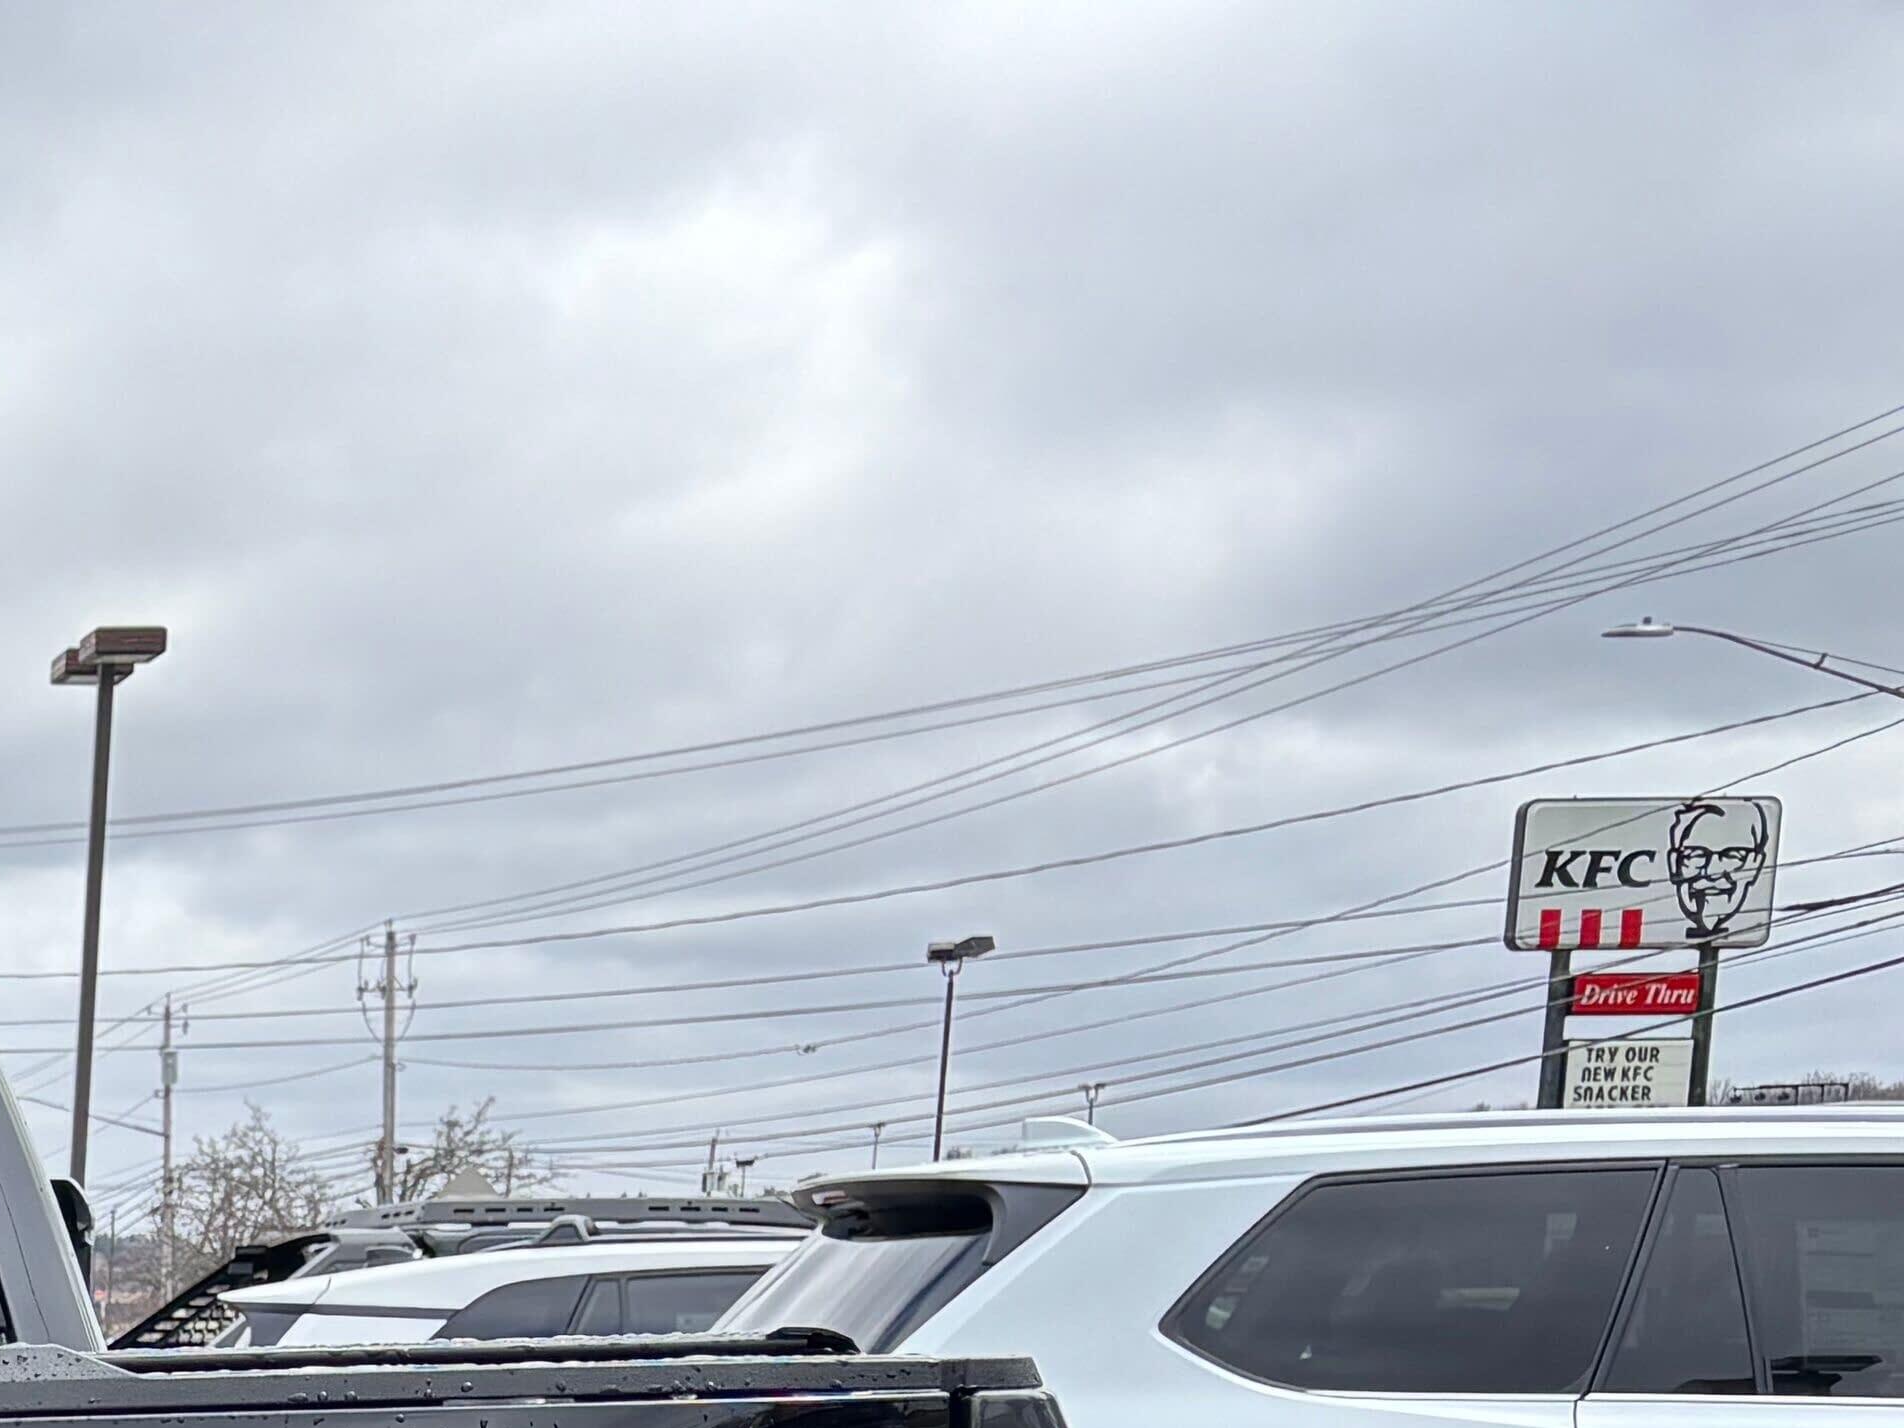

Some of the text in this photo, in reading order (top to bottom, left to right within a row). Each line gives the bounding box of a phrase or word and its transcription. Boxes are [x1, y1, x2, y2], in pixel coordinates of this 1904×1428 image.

[1535, 850, 1657, 888] KFC
[1580, 984, 1696, 1006] Drive Thru
[1586, 1046, 1660, 1063] TRY OUR
[1621, 1066, 1655, 1082] KFC
